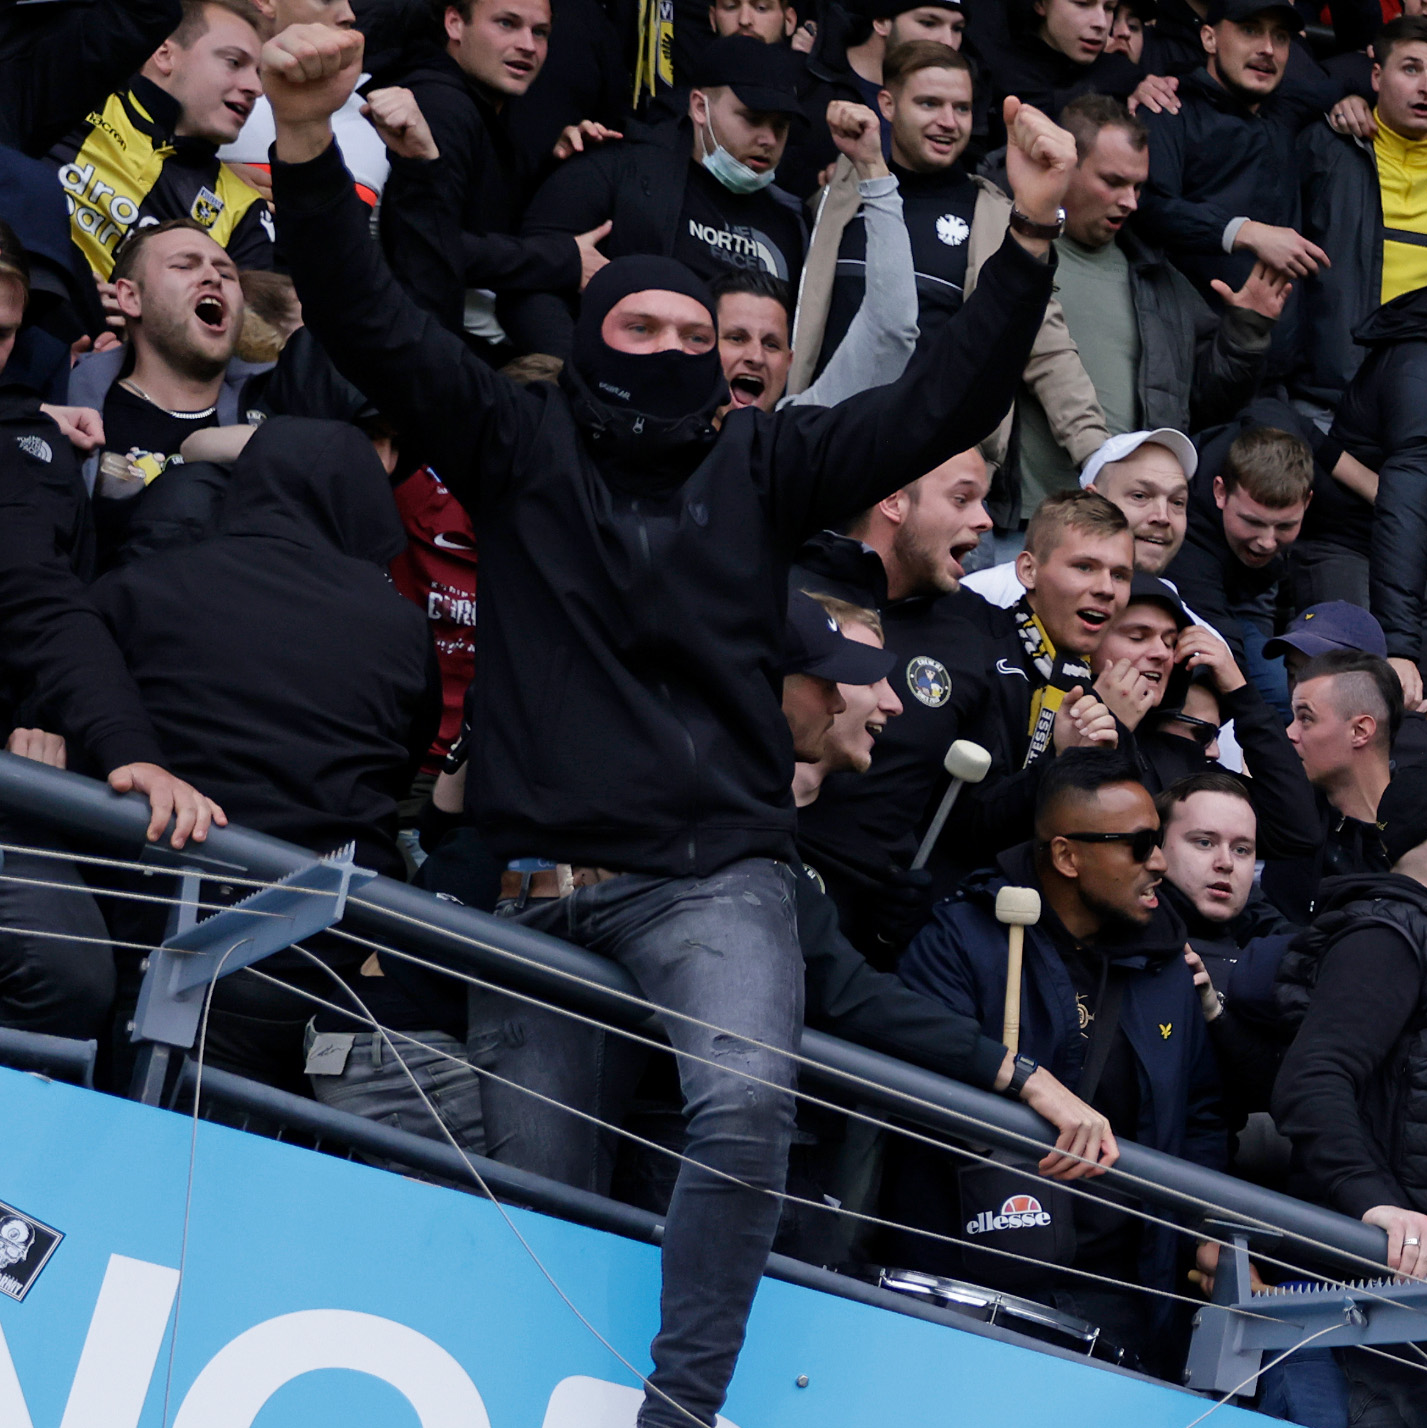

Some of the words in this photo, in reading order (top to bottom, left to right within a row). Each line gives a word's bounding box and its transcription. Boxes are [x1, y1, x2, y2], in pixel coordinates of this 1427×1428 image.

[688, 217, 758, 258] NORTH
[1028, 709, 1054, 766] TESSE
[966, 1210, 1052, 1235] ellesse
